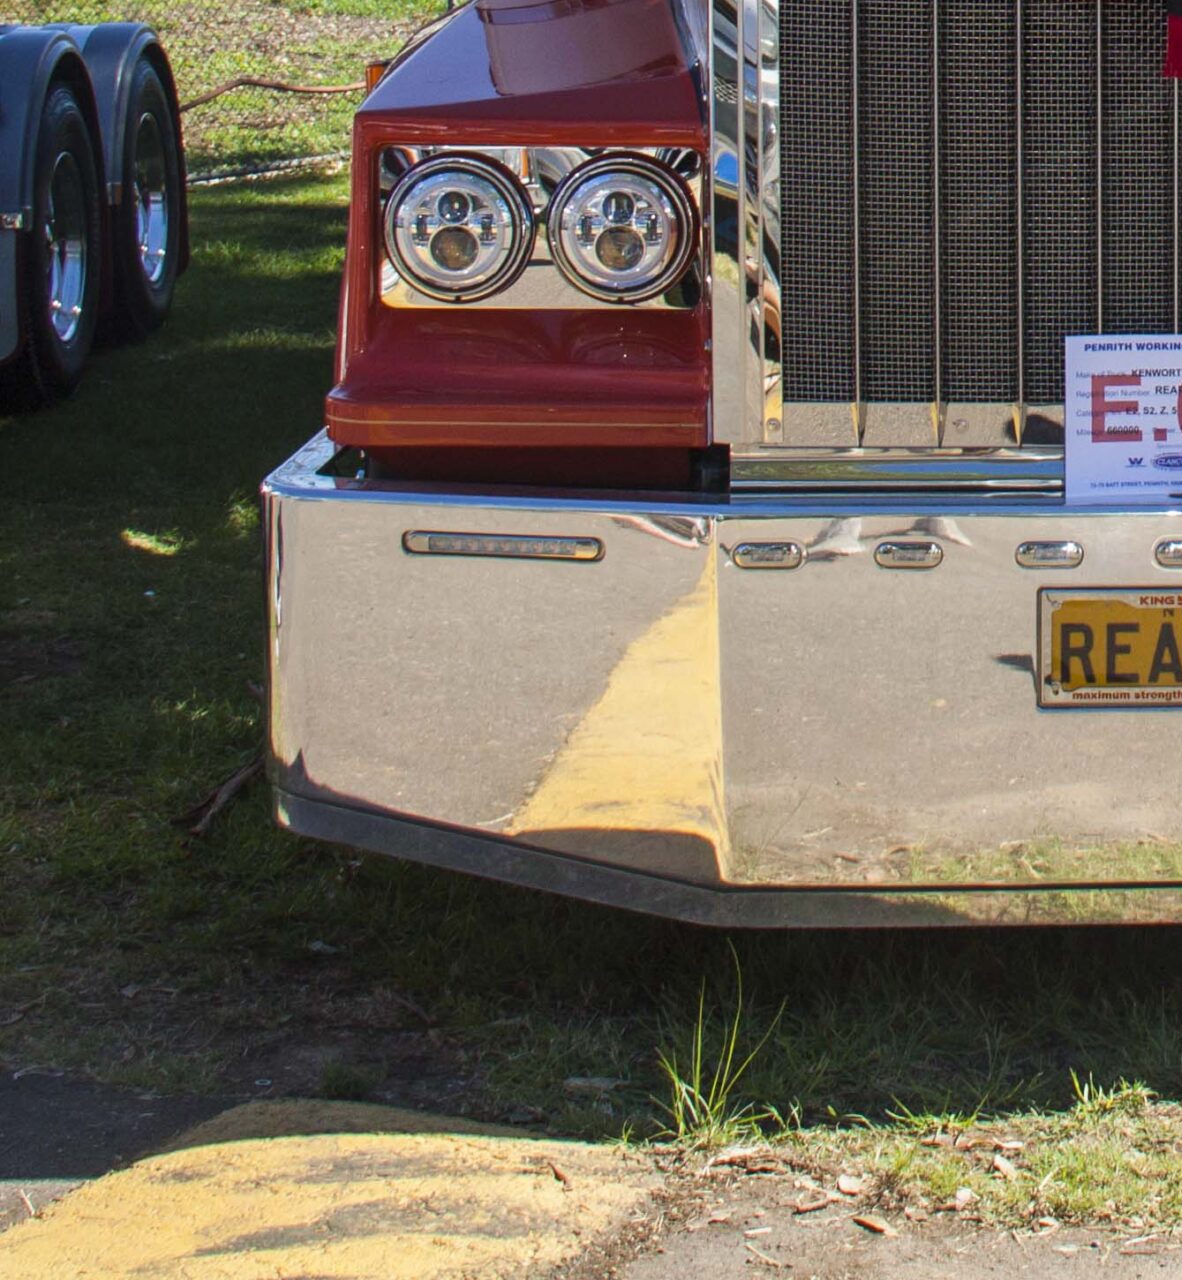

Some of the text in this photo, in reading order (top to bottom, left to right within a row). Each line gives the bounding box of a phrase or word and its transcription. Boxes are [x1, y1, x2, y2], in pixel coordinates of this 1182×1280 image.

[1084, 342, 1133, 352] PENRITH
[1139, 596, 1175, 606] KING
[1072, 691, 1131, 700] maximum
